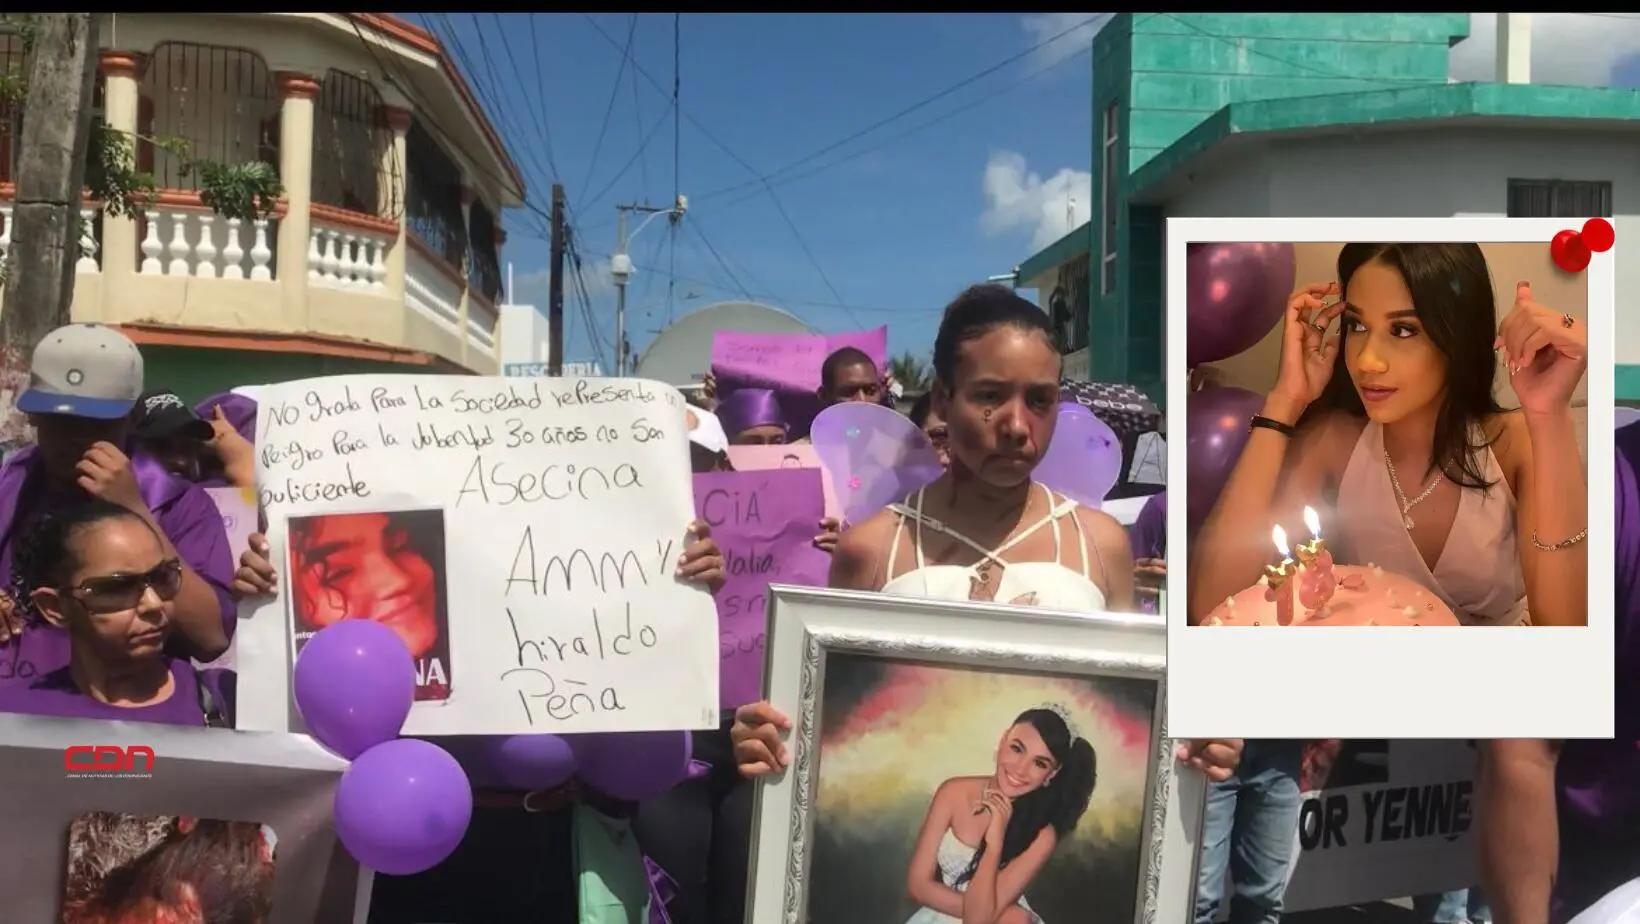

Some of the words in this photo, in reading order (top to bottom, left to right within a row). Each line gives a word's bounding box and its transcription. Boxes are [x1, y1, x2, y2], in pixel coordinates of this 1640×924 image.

[509, 361, 602, 377] PESCDERIA
[1075, 394, 1143, 412] bebe
[504, 418, 535, 448] 30
[596, 425, 619, 443] no
